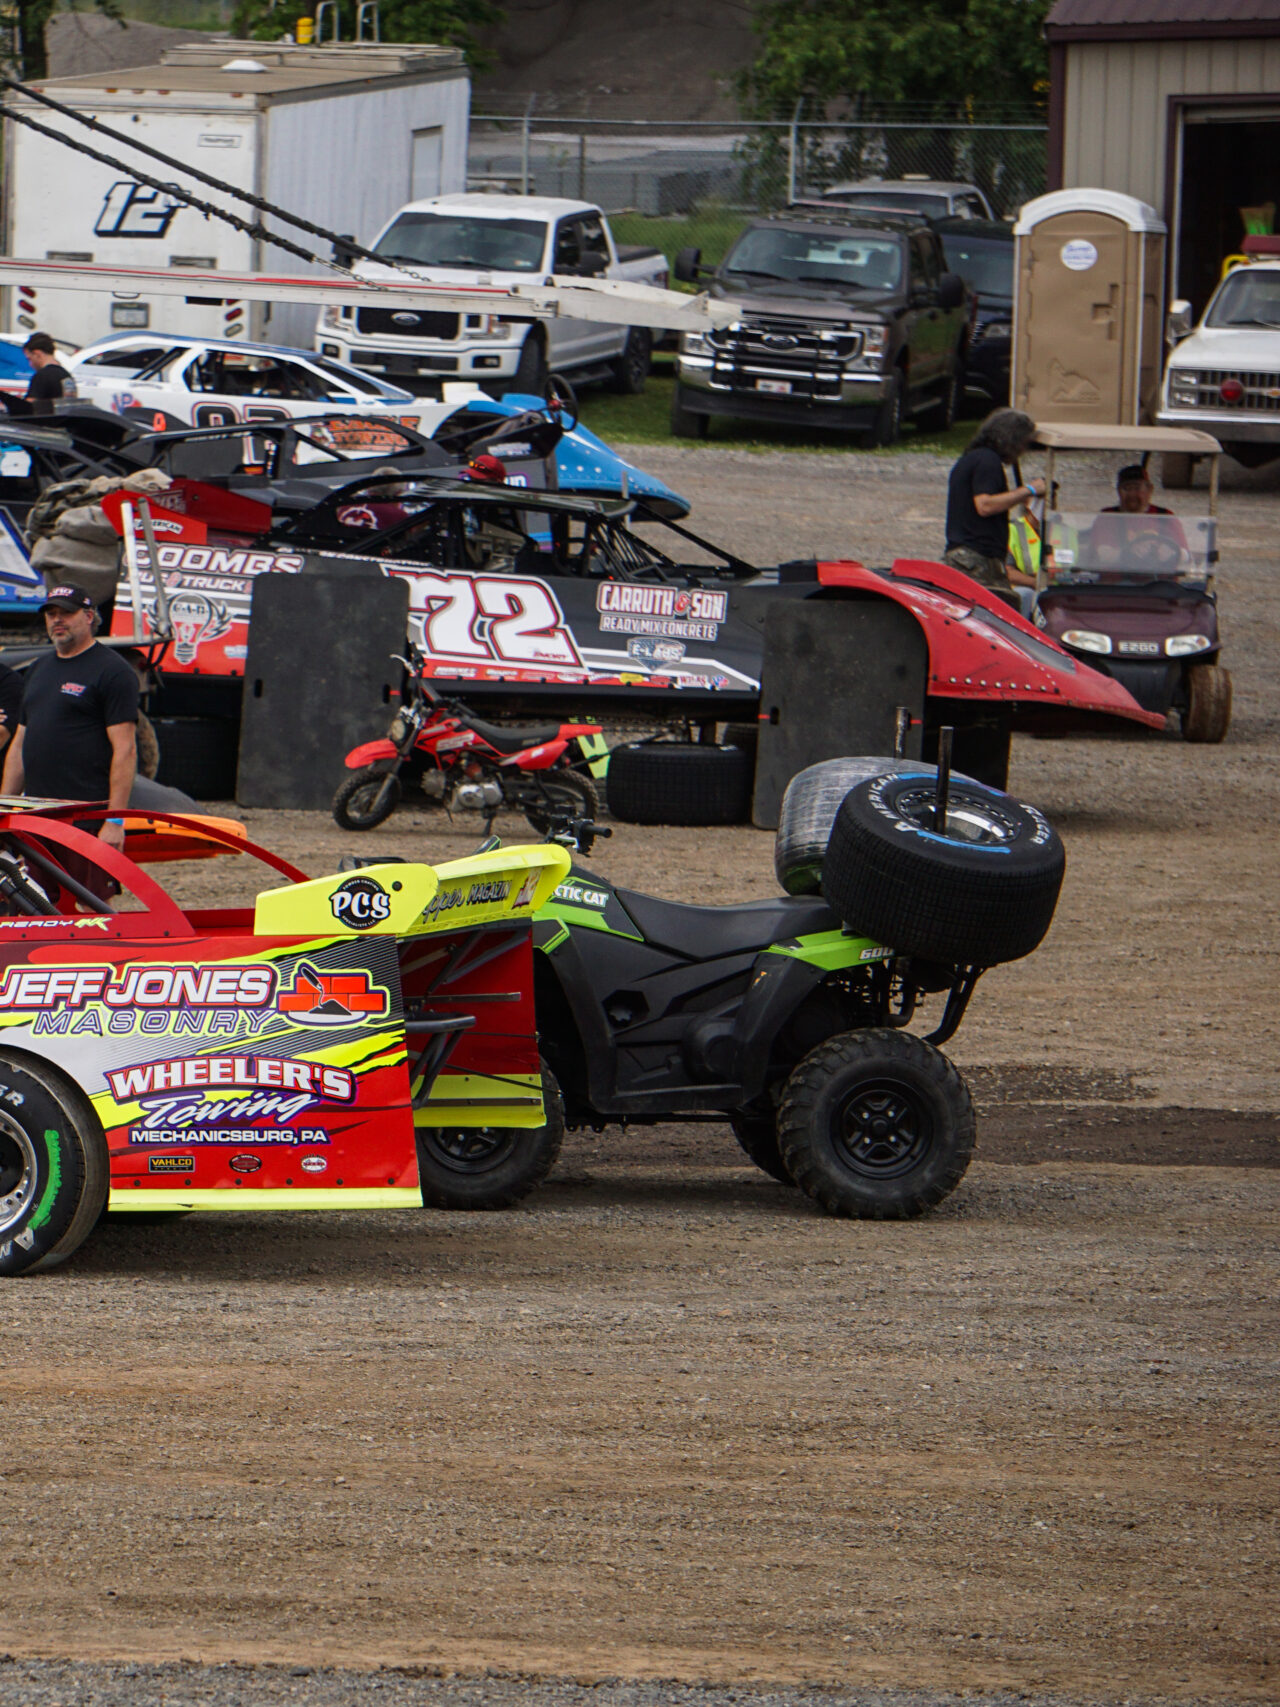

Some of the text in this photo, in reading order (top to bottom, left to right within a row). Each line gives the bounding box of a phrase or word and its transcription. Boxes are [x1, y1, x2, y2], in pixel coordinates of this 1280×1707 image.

[182, 577, 246, 591] TRUCK
[392, 570, 582, 666] 72
[600, 584, 724, 620] CARRUTH & SON
[602, 616, 716, 639] READY MIX CONCRETE
[868, 773, 921, 832] AMERICAN
[1019, 803, 1051, 846] RACER
[329, 891, 390, 919] PCS
[552, 884, 609, 906] CTIC CAT
[107, 968, 273, 1005] JONES
[33, 1008, 279, 1036] MASONRY
[110, 1057, 353, 1100] WHEELER'S
[142, 1092, 319, 1128] Towing
[131, 1129, 327, 1145] MECHANICSBURG, PA
[151, 1158, 192, 1166] VAHLCO
